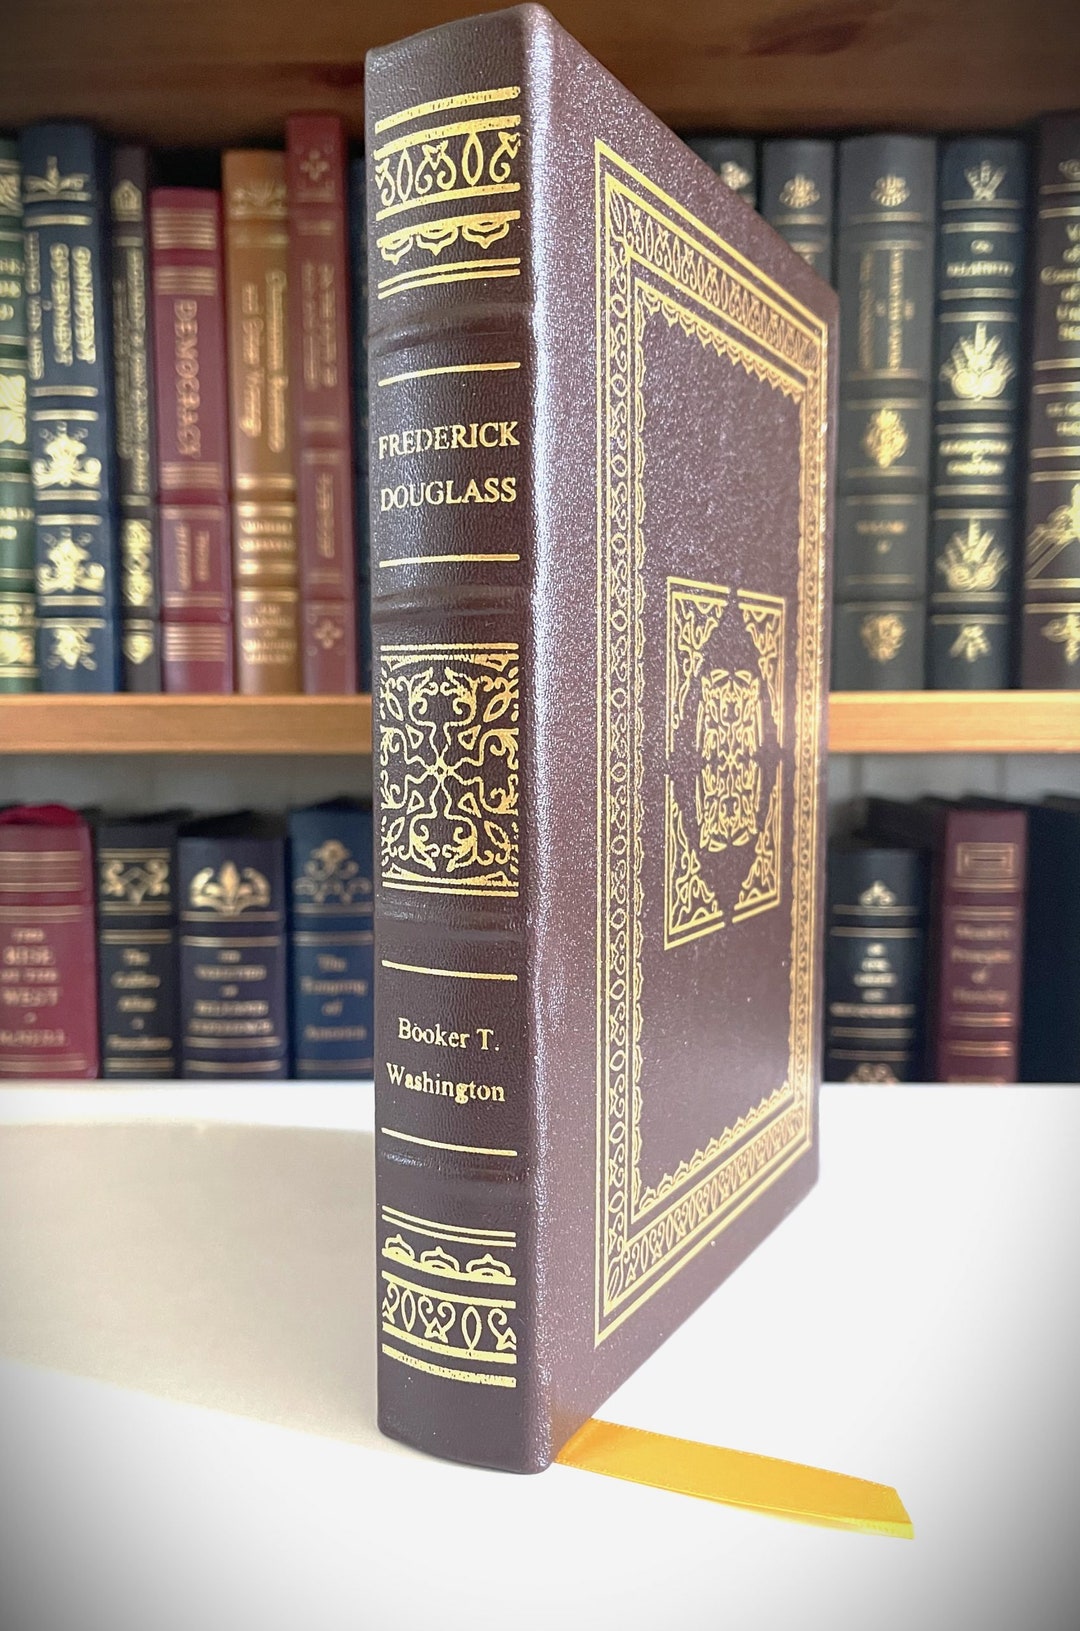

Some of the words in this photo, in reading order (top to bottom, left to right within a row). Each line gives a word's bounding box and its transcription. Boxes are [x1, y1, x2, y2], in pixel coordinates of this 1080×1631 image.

[174, 299, 201, 459] DEMOCRACY
[378, 421, 521, 460] FREDERICK
[380, 477, 517, 512] DOUGLASS
[398, 1017, 470, 1049] Booker
[476, 1028, 500, 1051] T.
[386, 1062, 506, 1104] Washington
